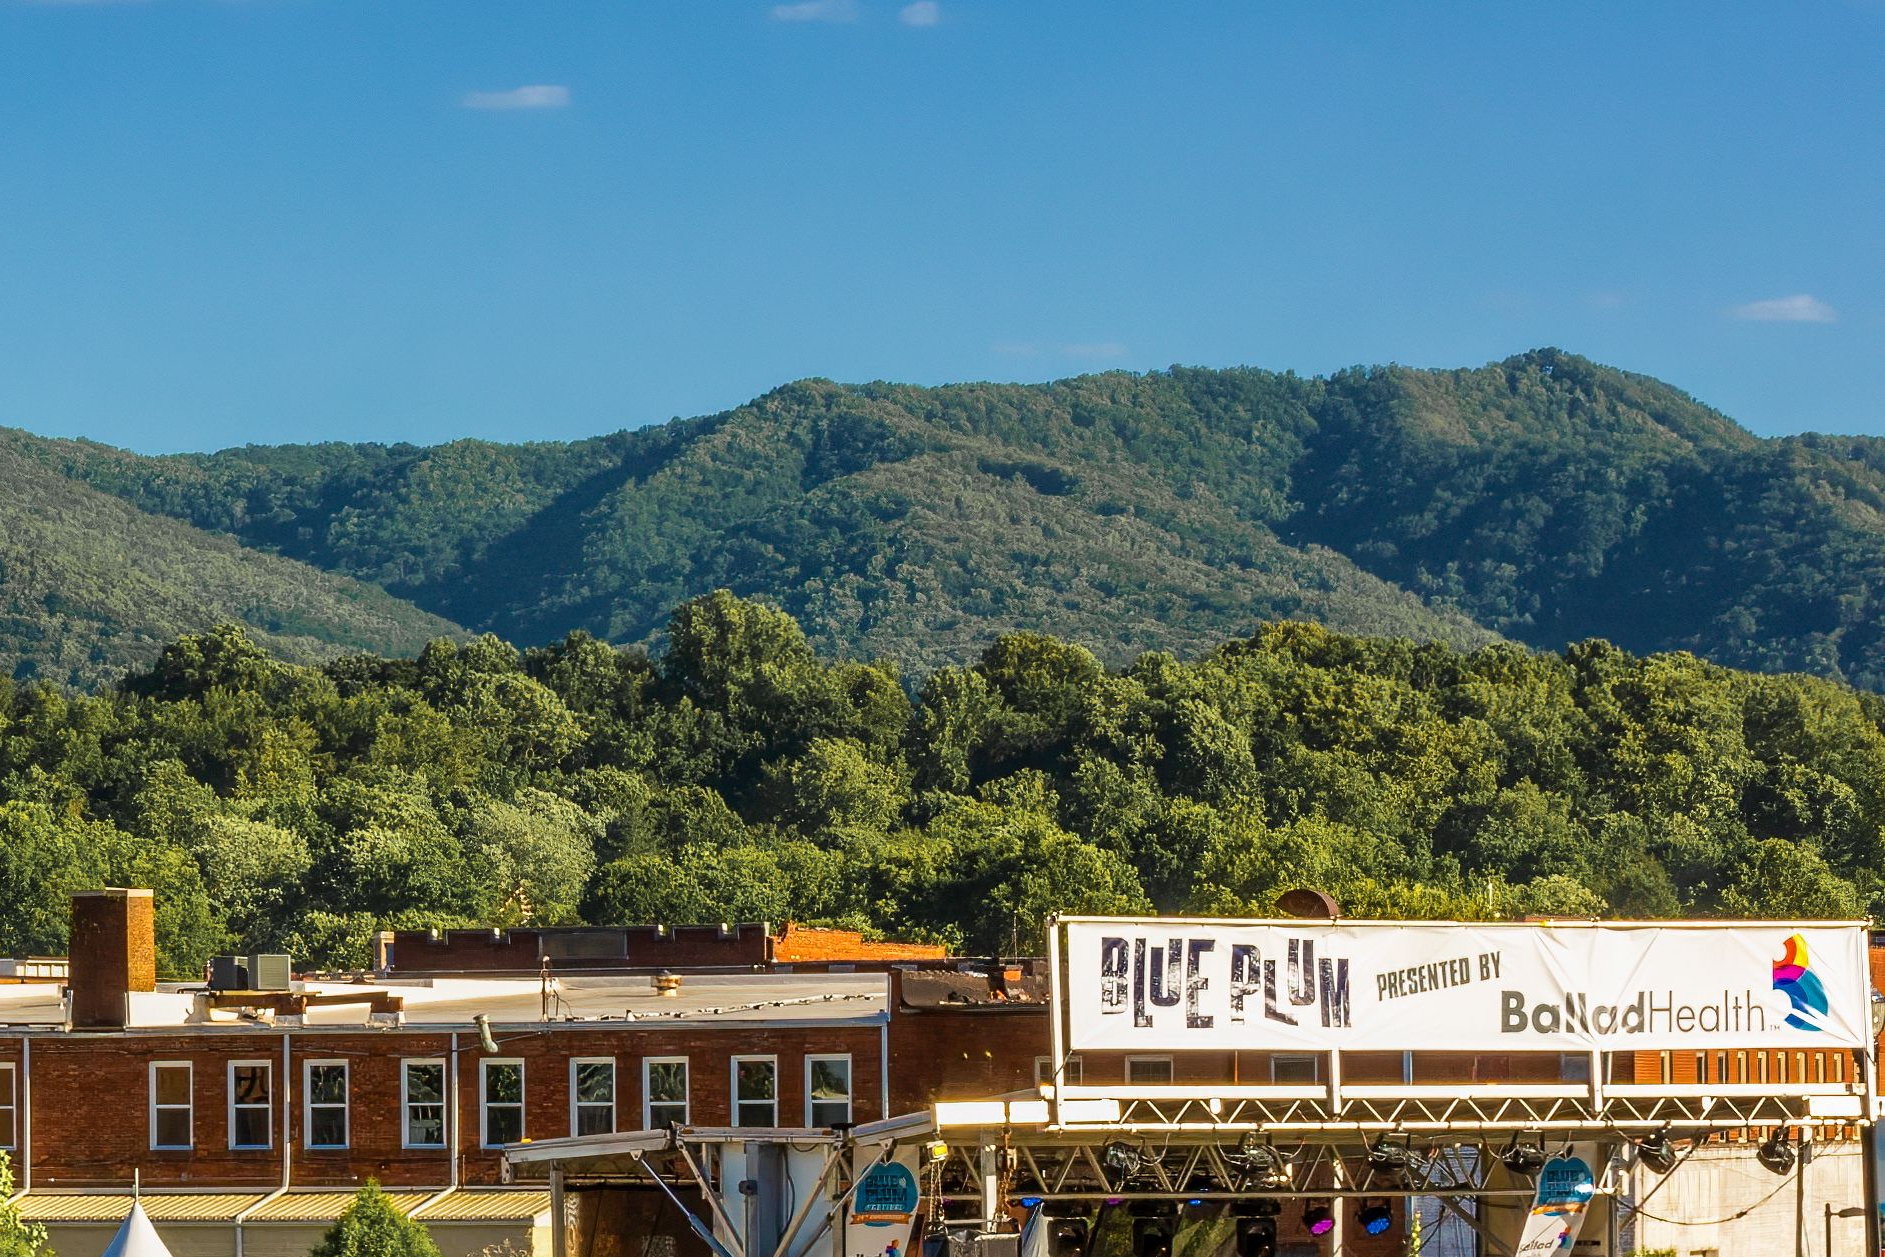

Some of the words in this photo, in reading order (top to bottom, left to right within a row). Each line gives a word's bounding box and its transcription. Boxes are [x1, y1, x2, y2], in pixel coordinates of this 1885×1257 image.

[1101, 936, 1216, 1029] BLUE
[1230, 938, 1352, 1029] PLUM
[1376, 957, 1470, 1001] PRESENTED
[1479, 951, 1502, 981] BY
